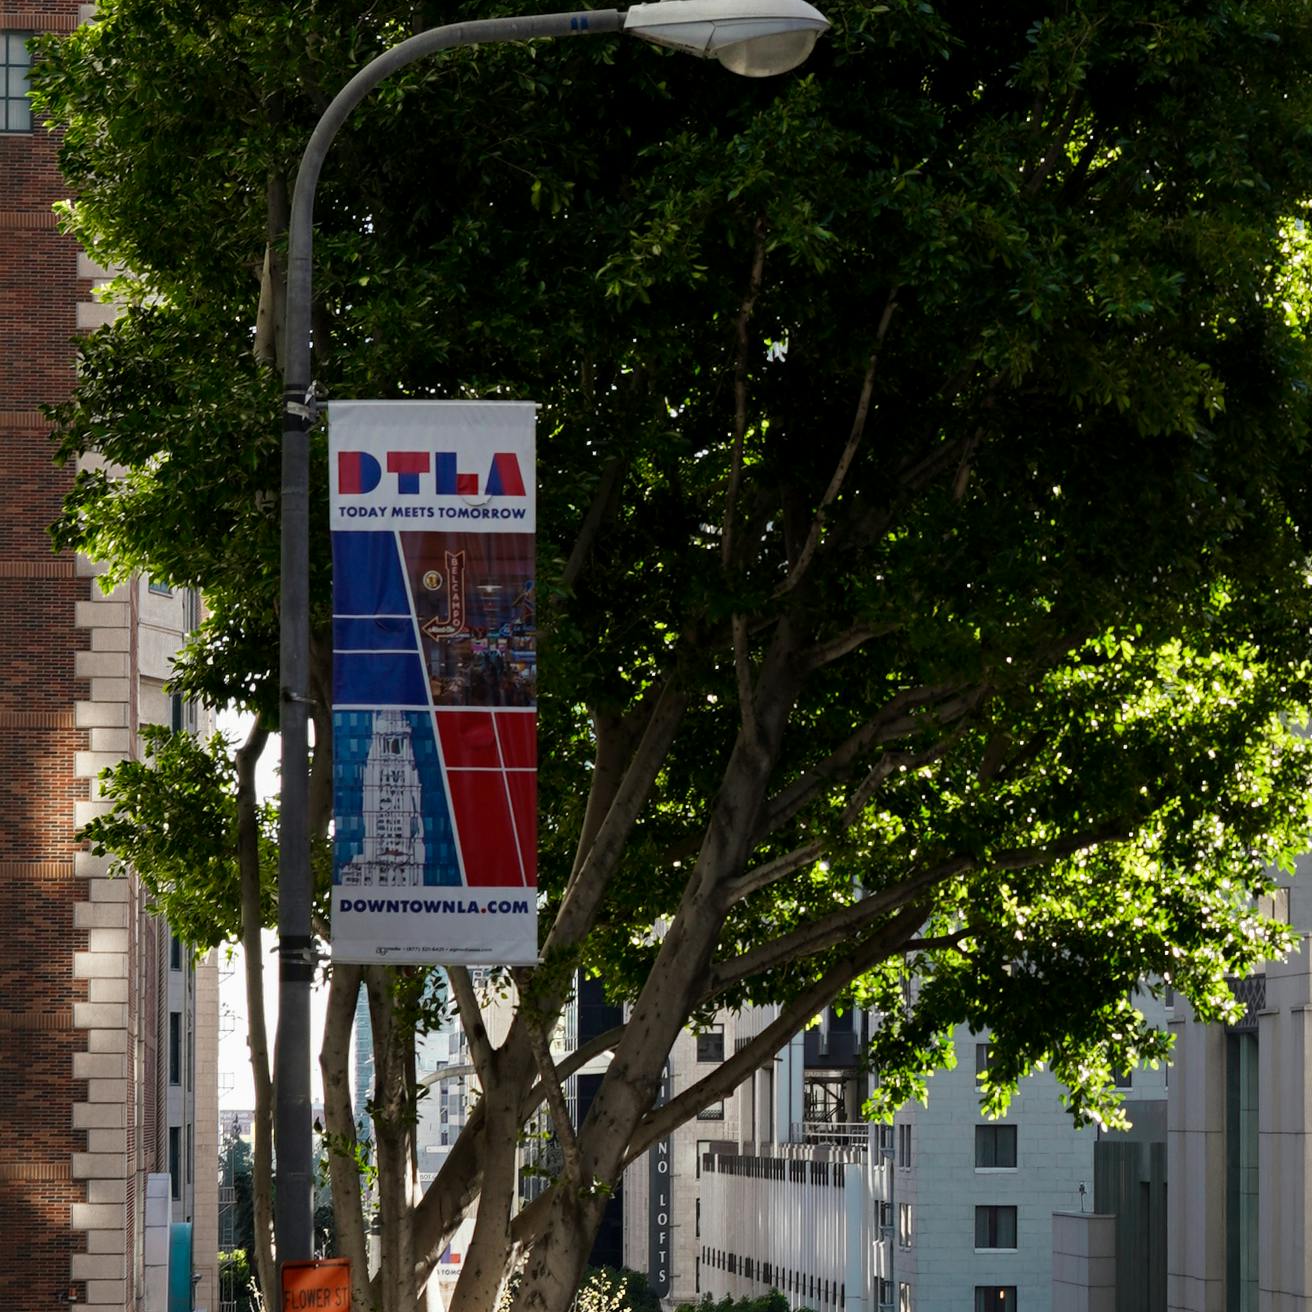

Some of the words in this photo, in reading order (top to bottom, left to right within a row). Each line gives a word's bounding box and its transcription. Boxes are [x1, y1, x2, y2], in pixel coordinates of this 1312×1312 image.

[338, 451, 526, 496] DTLA
[339, 506, 387, 517] TODAY
[391, 506, 434, 518] MEETS
[438, 507, 526, 519] TOMORROW
[451, 558, 461, 626] BELCAMPO
[340, 899, 529, 914] DOWNTOWNLA.COM
[657, 1194, 667, 1283] LOFTS
[284, 1288, 331, 1309] FLOWER
[336, 1287, 348, 1305] ST
